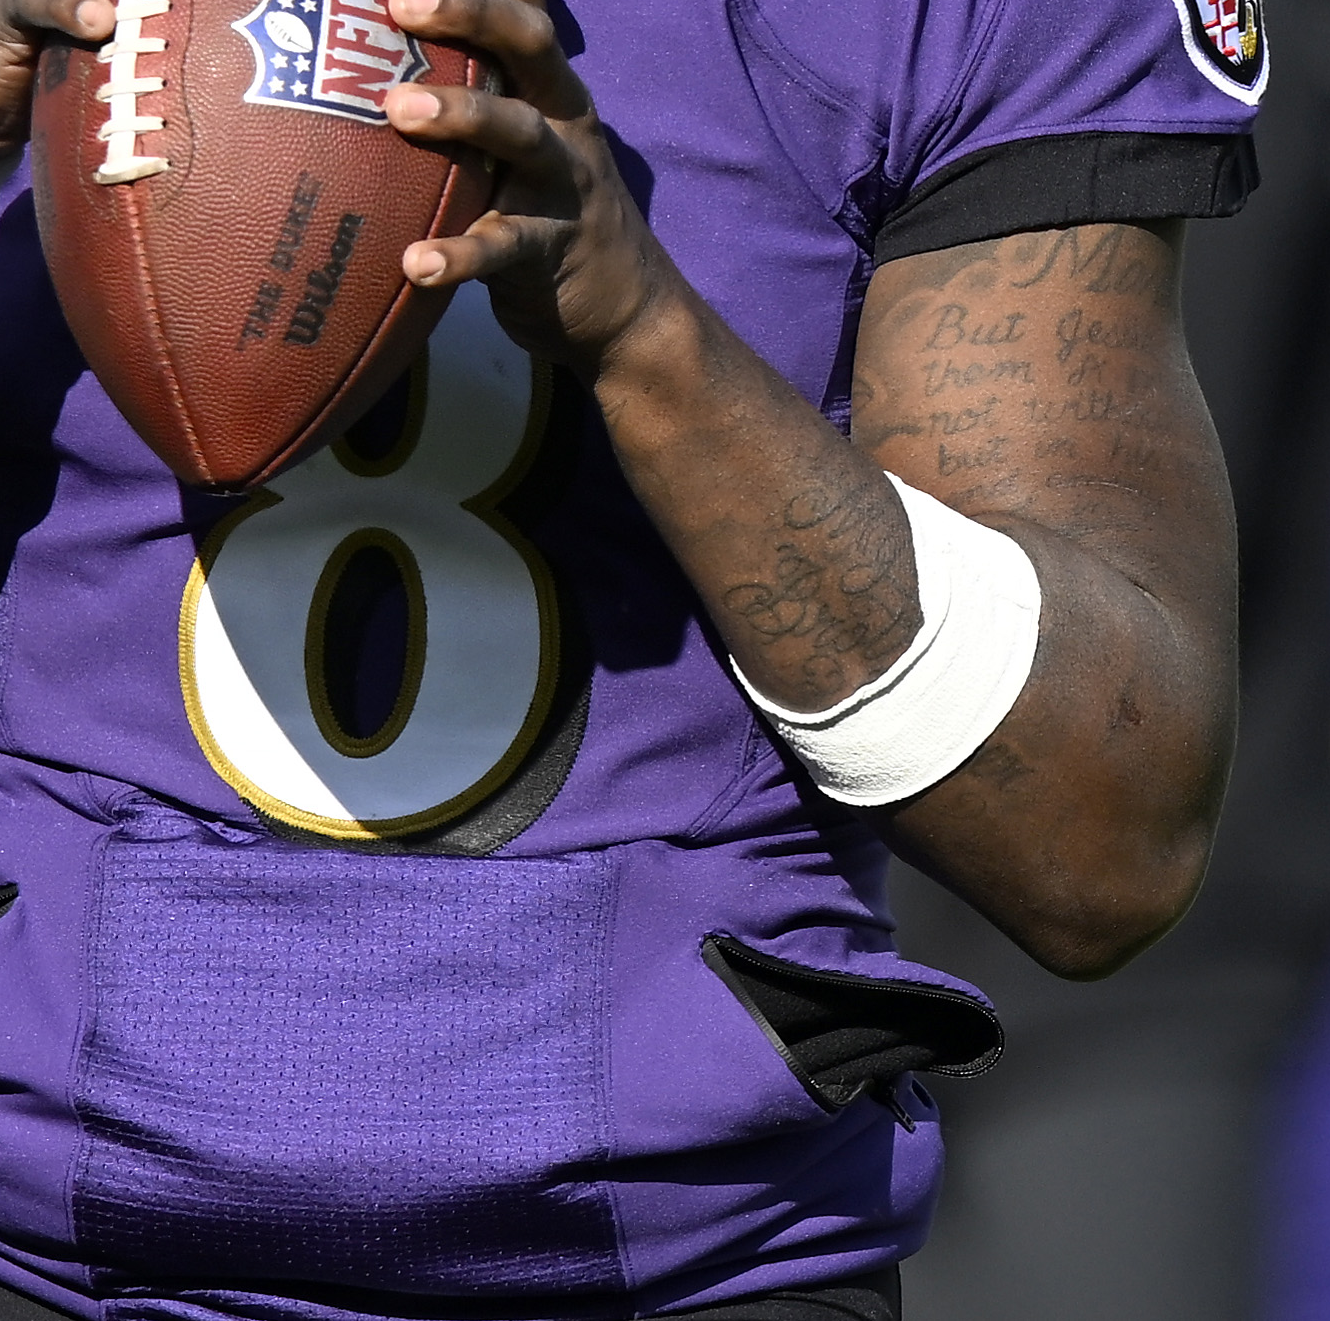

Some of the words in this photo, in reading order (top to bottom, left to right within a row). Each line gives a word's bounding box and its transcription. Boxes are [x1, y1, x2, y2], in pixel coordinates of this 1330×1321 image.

[283, 212, 366, 348] Wilson
[916, 304, 1026, 353] But
[178, 286, 565, 844] 8
